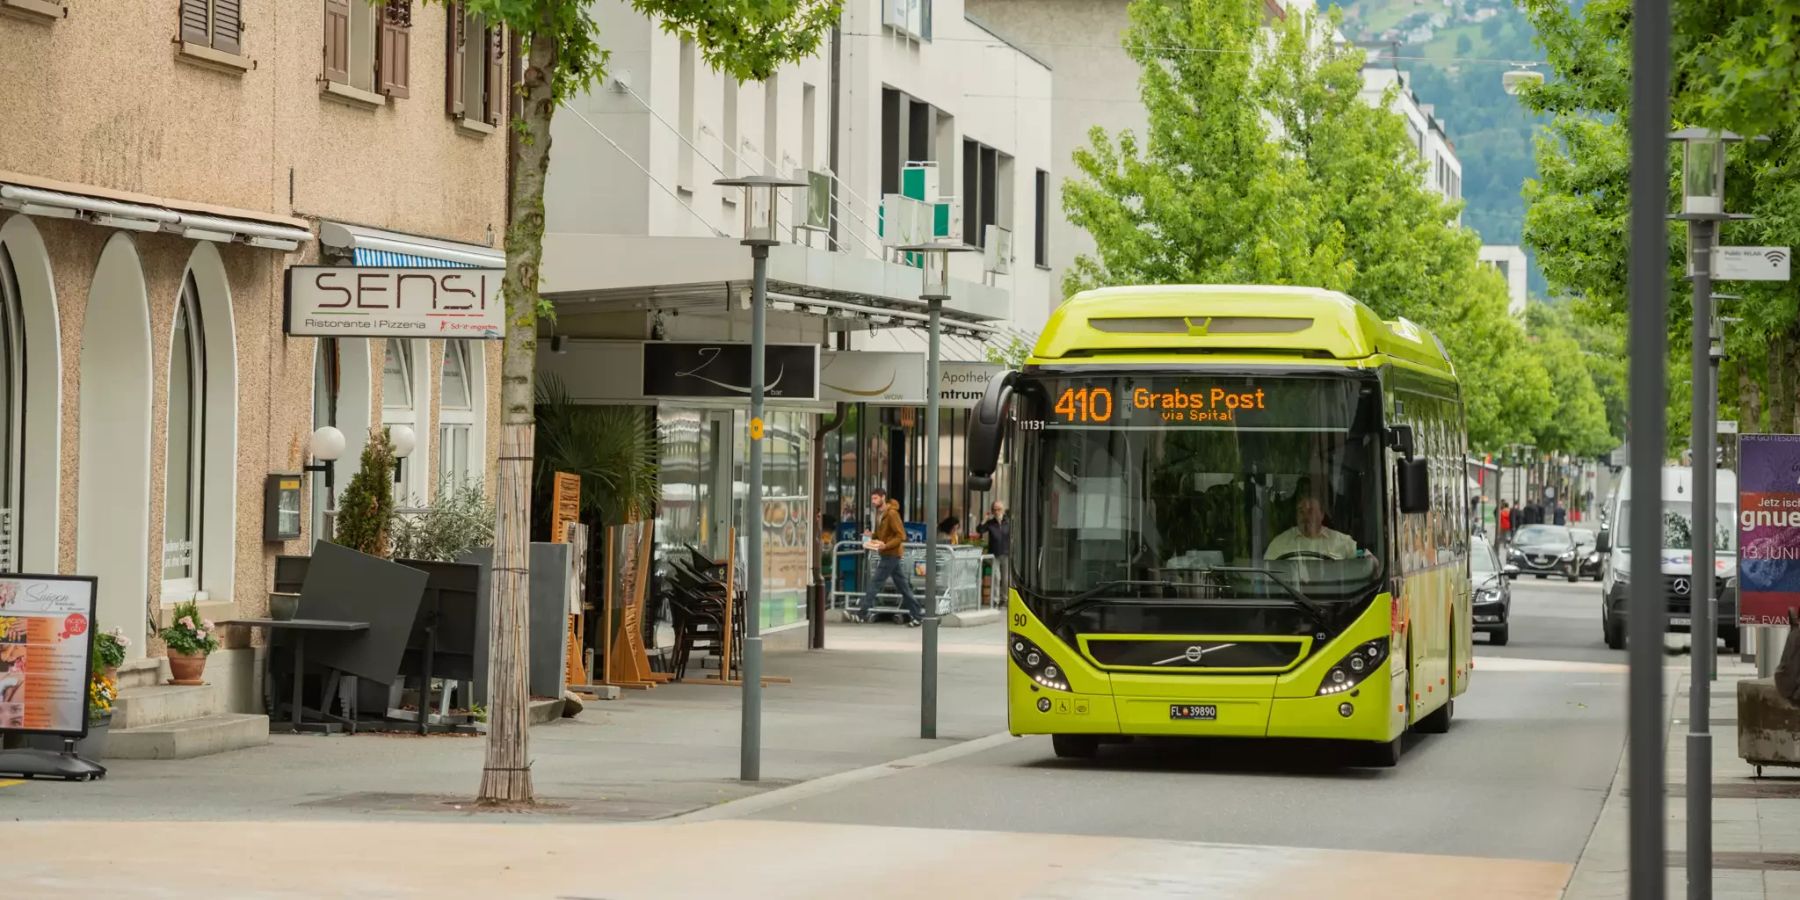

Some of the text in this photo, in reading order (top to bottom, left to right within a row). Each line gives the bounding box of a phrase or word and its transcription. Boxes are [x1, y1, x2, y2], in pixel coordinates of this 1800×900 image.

[305, 318, 371, 329] Ristorante
[379, 319, 426, 330] Pizzeria
[770, 387, 783, 396] bar
[927, 388, 984, 400] ntrum
[1054, 387, 1265, 422] 410 Grabs Post
[1161, 409, 1233, 422] via Spital
[1757, 497, 1780, 506] Jetz
[1741, 510, 1800, 532] gnue
[1014, 613, 1027, 627] 90
[1171, 706, 1216, 716] FL 39890
